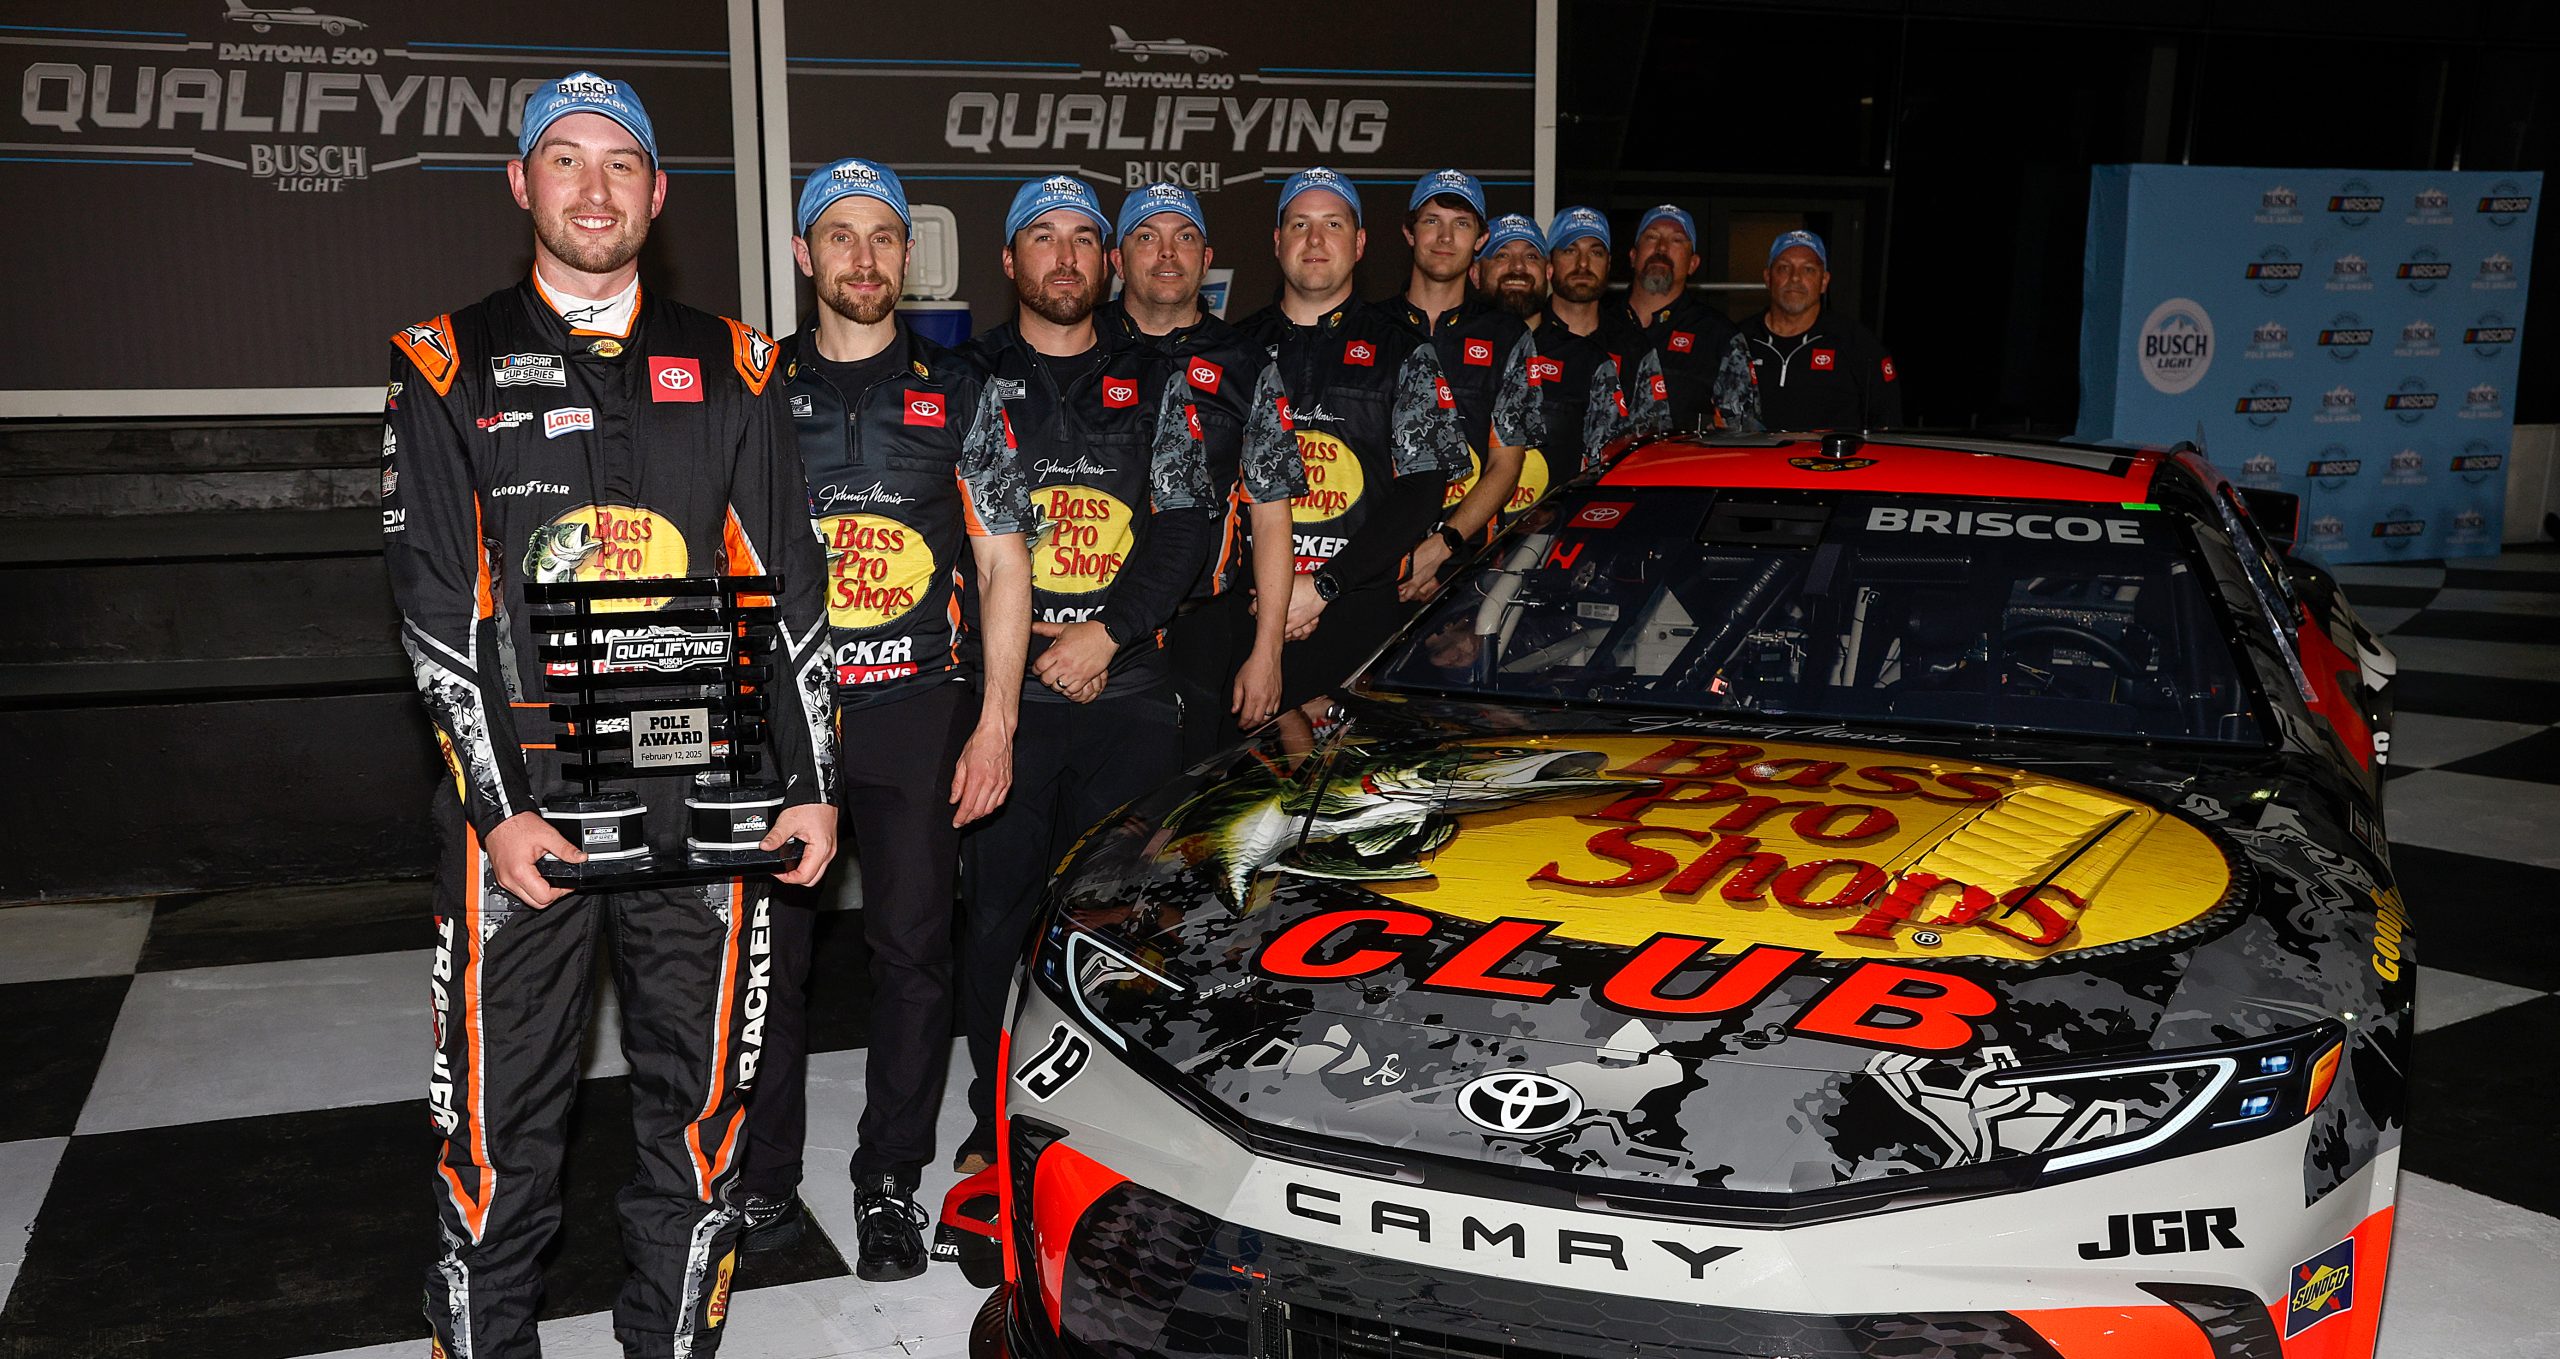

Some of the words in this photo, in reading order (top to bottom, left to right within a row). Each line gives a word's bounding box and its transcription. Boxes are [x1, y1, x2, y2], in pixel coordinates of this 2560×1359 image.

[218, 42, 328, 64] DAYTONA
[331, 48, 378, 66] 500
[557, 81, 618, 95] BUSCH
[1105, 71, 1194, 90] DAYTONA
[1196, 73, 1235, 91] 500
[21, 62, 528, 137] QUALIFYIN
[549, 97, 580, 112] POLE
[945, 92, 1389, 153] QUALIFYING
[250, 144, 369, 180] BUSCH
[832, 169, 880, 180] BUSCH
[1125, 160, 1221, 192] BUSCH
[277, 178, 344, 192] LIGHT
[1042, 181, 1084, 194] BUSCH
[1147, 188, 1185, 199] BUSCH
[2146, 335, 2207, 356] BUSCH
[504, 368, 521, 380] CUP
[522, 368, 554, 379] SERIES
[514, 355, 552, 367] NASCAR
[2158, 358, 2192, 368] LIGHT
[547, 413, 590, 429] Lance
[1034, 458, 1077, 482] Johnny
[1075, 455, 1117, 479] Morris
[1303, 461, 1325, 484] ro
[492, 480, 570, 497] GOODYEAR
[818, 484, 869, 511] Johnny
[866, 481, 915, 508] Morris
[1047, 490, 1110, 520] Bass
[592, 511, 653, 542] Bass
[832, 518, 905, 551] Bass
[1049, 519, 1098, 547] Pro
[1865, 506, 2146, 546] BRISCOE
[594, 542, 643, 572] Pro
[832, 552, 888, 580] Pro
[1050, 547, 1122, 584] Shops
[831, 578, 914, 616] Shops
[615, 640, 724, 660] QUALIFYING
[658, 657, 683, 667] BUSCH
[835, 636, 914, 665] CKER
[846, 673, 856, 683] &
[649, 715, 690, 730] POLE
[1628, 715, 1791, 740] Johnny
[1785, 723, 1962, 746] Morris
[638, 731, 703, 747] AWARD
[641, 751, 673, 762] February
[675, 752, 684, 760] 12,
[686, 751, 702, 759] 2025
[1606, 738, 2004, 802] Bass
[1576, 777, 1900, 842] Pro
[733, 822, 767, 831] DAYTONA
[1526, 824, 2087, 948] Shops
[1257, 907, 1999, 1052] CLUB
[1013, 1022, 1091, 1101] 19
[1285, 1181, 1742, 1280] CAMRY
[2077, 1206, 2245, 1261] JGR
[710, 1267, 728, 1318] Bass
[2293, 1267, 2348, 1310] SUNOCO
